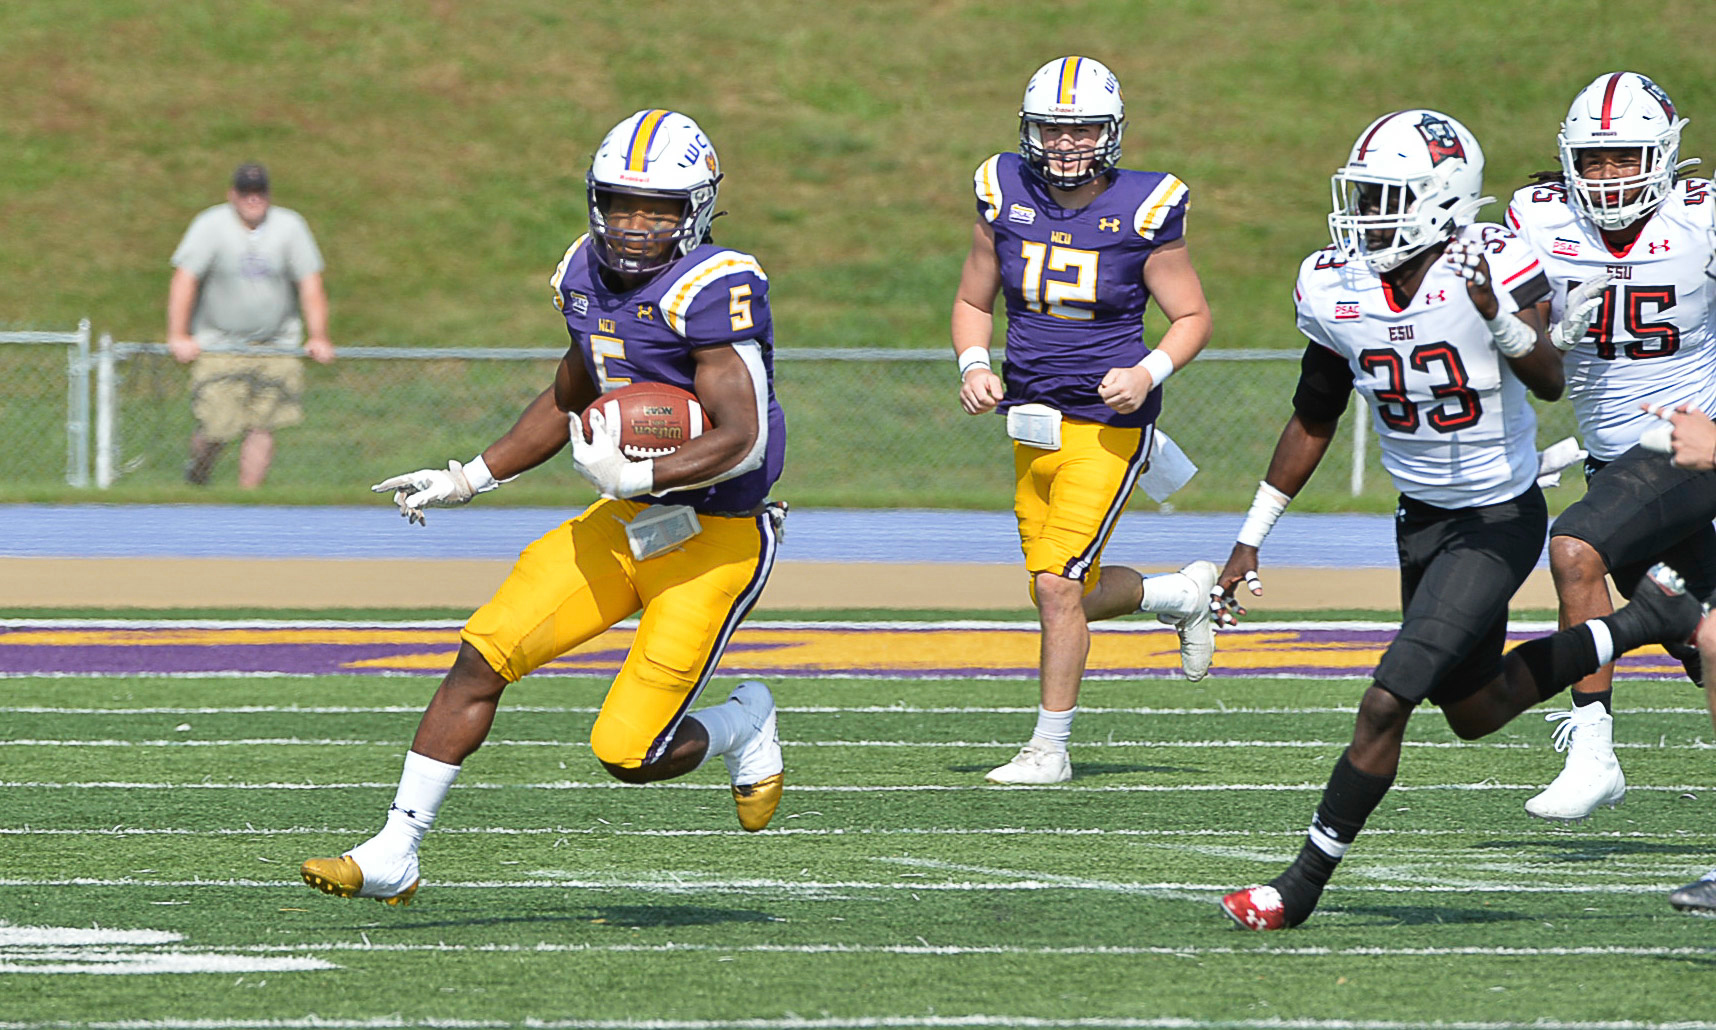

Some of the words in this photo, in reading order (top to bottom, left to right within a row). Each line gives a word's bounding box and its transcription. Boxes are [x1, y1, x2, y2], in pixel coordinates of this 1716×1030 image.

[1051, 230, 1072, 245] WCU
[1553, 241, 1580, 252] PSAC
[1021, 240, 1099, 321] 12
[1605, 265, 1632, 280] ESU
[729, 284, 754, 331] 5
[1335, 305, 1360, 315] PSAC
[1388, 324, 1415, 341] ESU
[1359, 341, 1483, 434] 33
